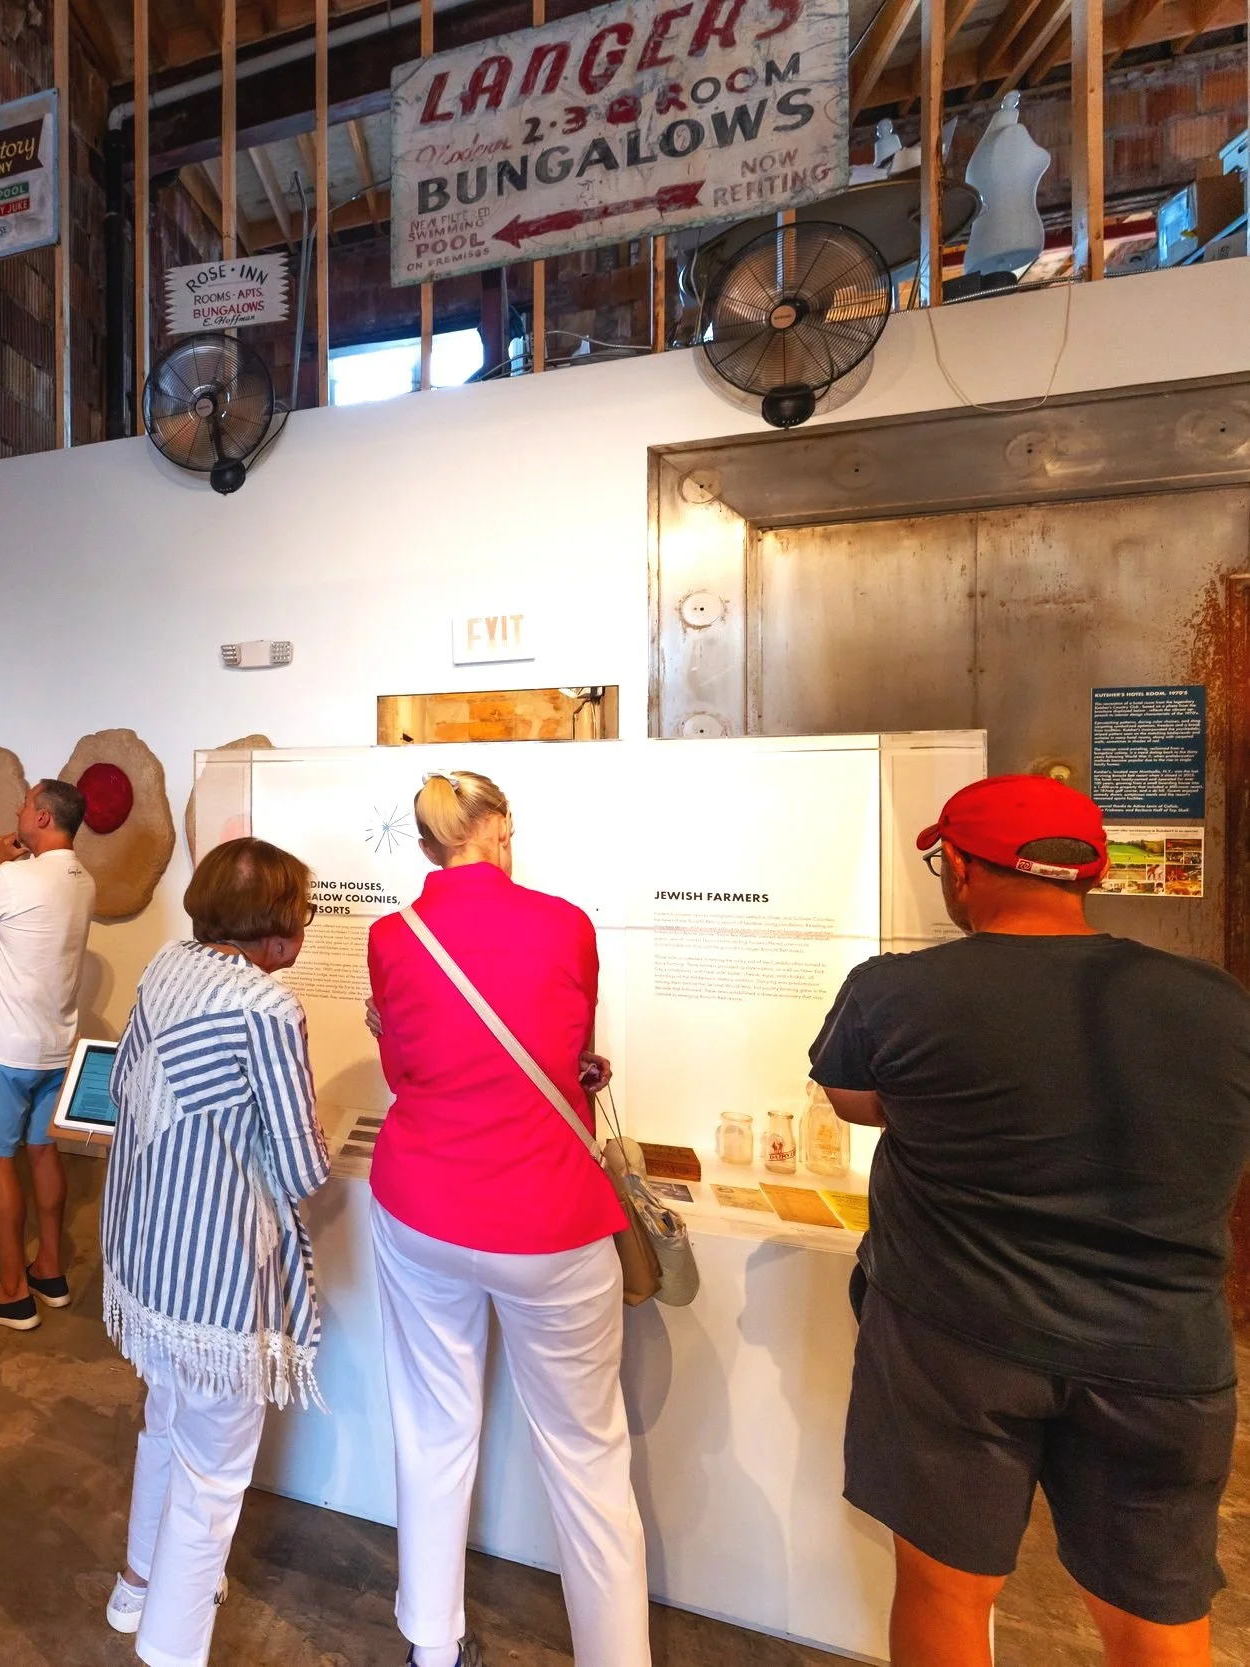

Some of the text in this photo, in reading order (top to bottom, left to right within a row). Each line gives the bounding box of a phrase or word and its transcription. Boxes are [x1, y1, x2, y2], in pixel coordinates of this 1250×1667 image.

[655, 52, 800, 115] ROOM
[417, 88, 814, 215] BUNGALOWS
[740, 148, 799, 176] NOW
[713, 163, 831, 207] RENTING
[7, 201, 28, 214] JUKE
[441, 206, 490, 224] FILTEED
[408, 218, 485, 242] SWIMMING
[416, 232, 485, 259] POOL
[406, 262, 423, 271] ON
[186, 264, 269, 293] ROSE INN
[194, 291, 231, 305] ROOMS
[193, 301, 264, 319] BUNGALOWS
[214, 314, 255, 326] Hoffman
[467, 614, 524, 652] EXIT
[311, 881, 384, 892] DING HOUSES,
[345, 894, 400, 905] COLONIES,
[654, 891, 769, 902] JEWISH FARMERS
